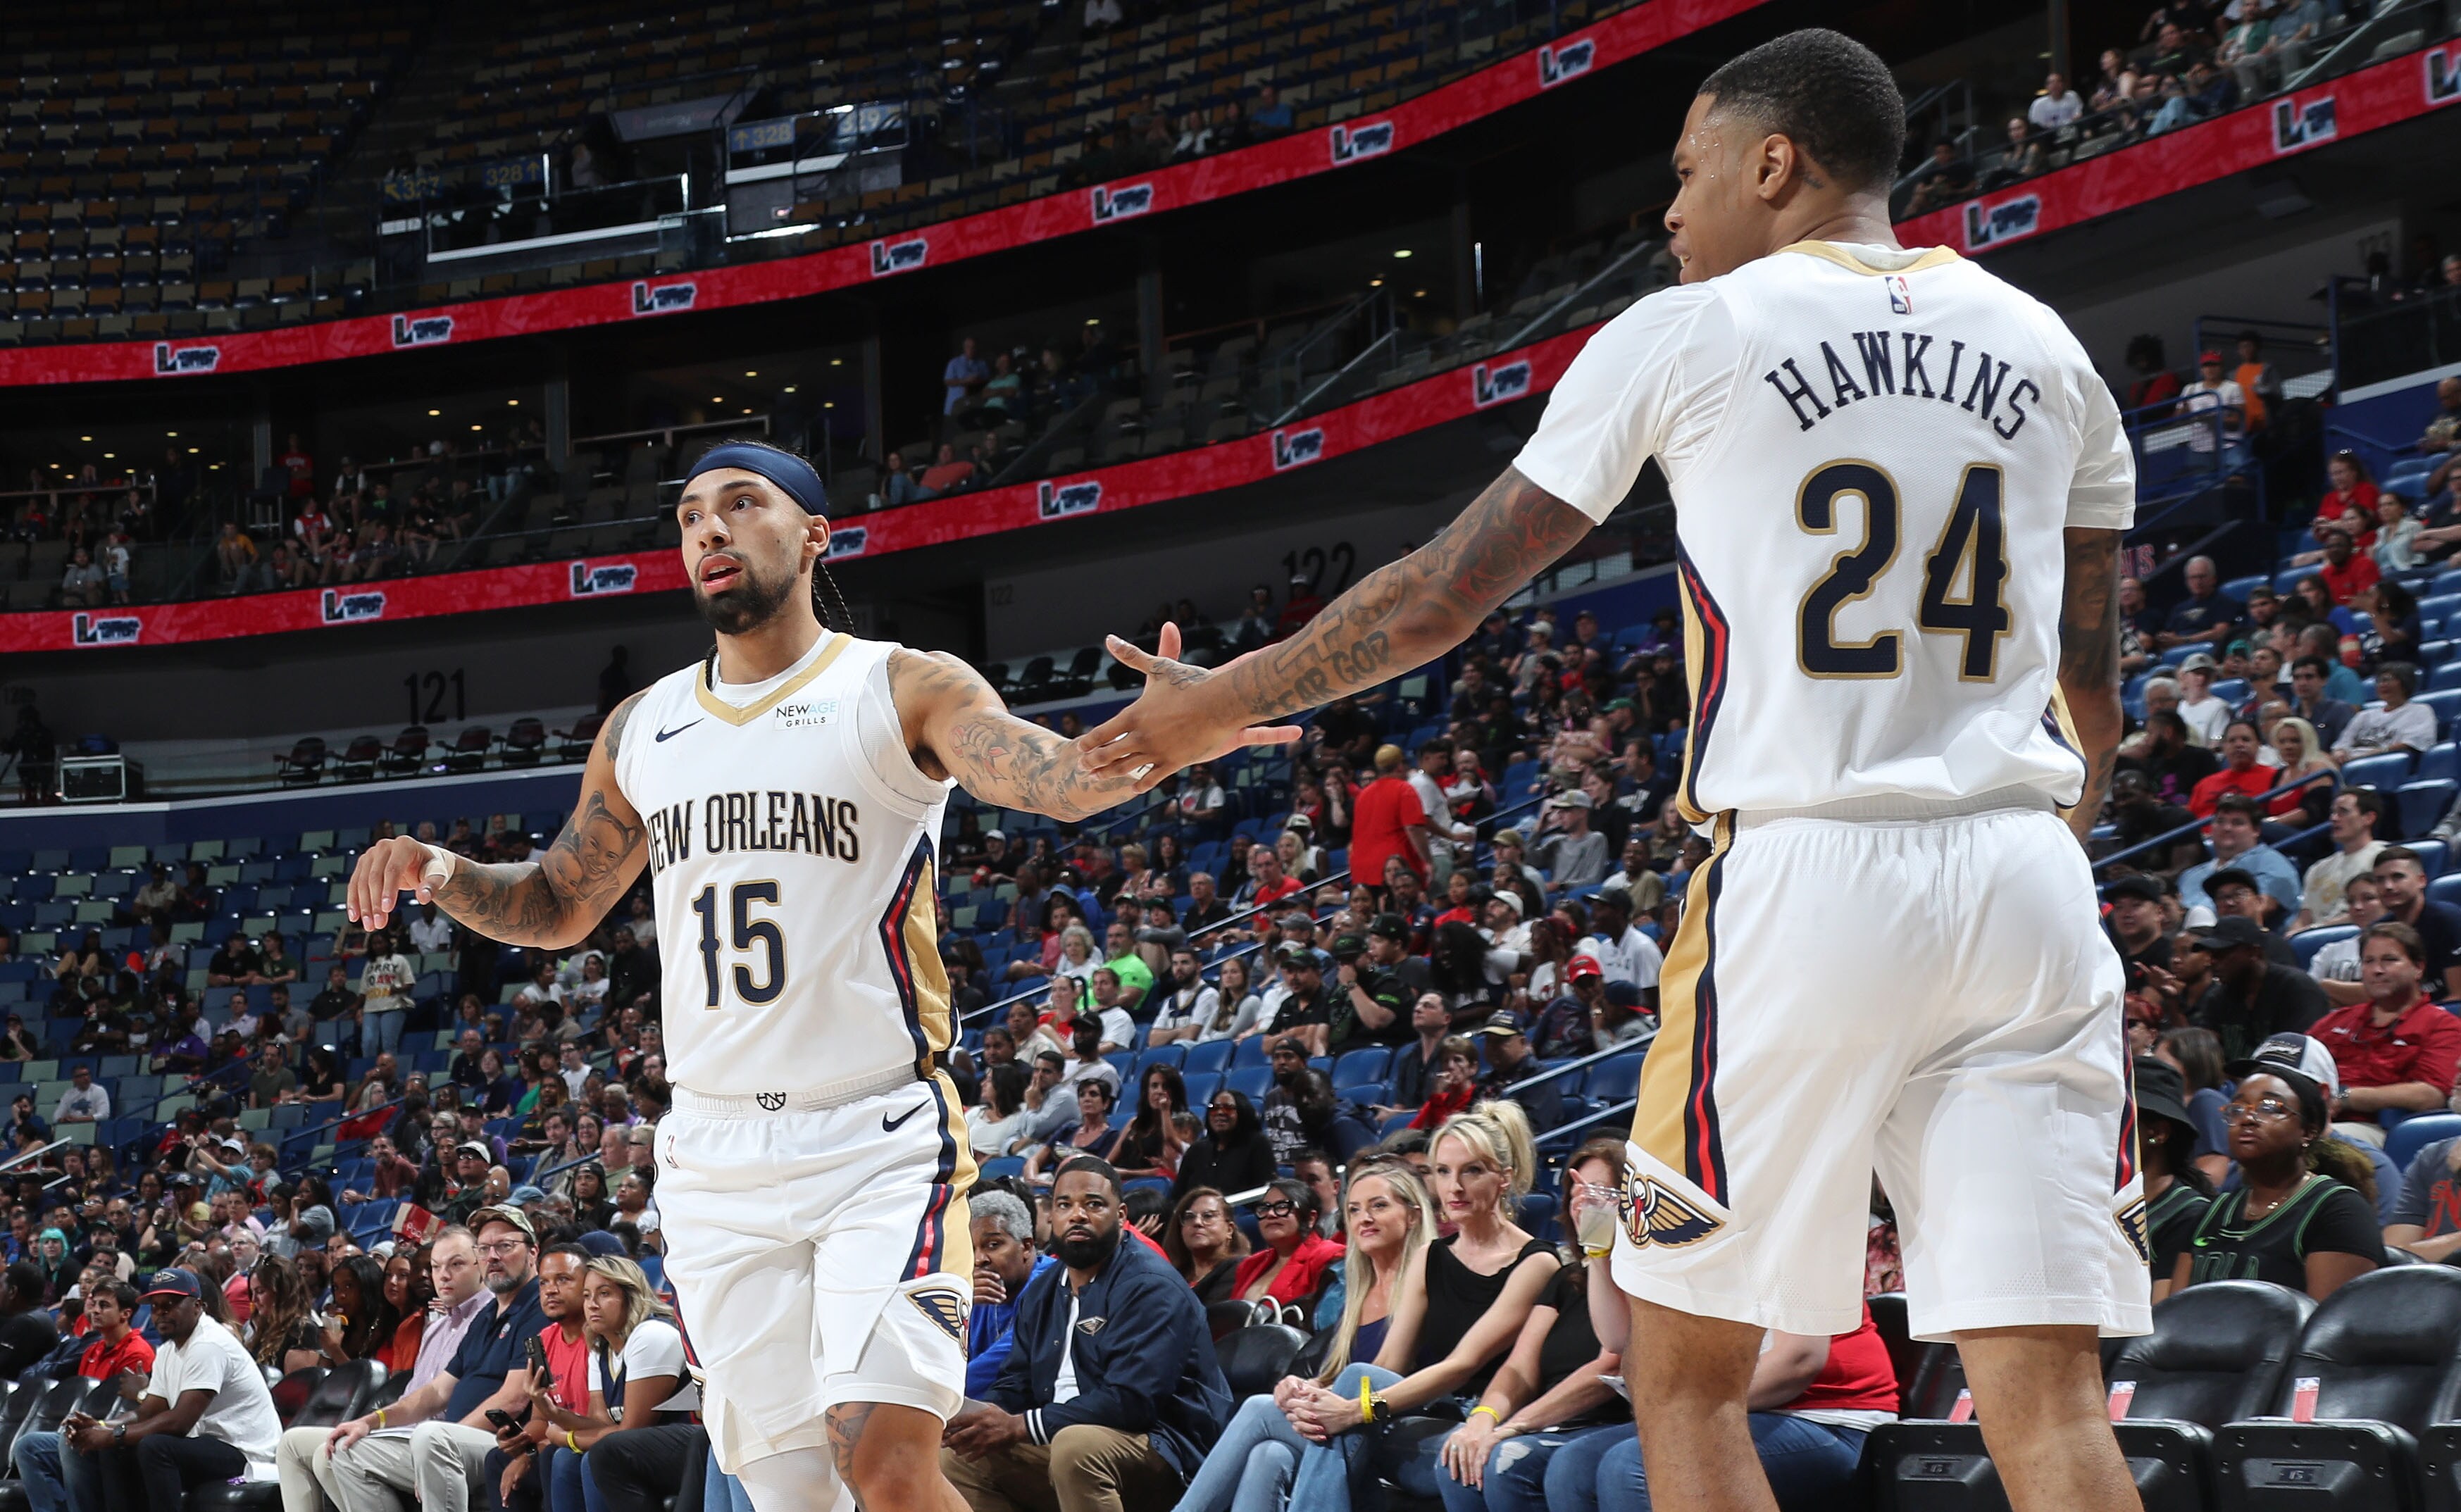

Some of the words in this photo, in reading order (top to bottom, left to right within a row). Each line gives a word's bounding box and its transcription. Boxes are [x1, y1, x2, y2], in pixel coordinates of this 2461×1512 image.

[1764, 331, 2040, 440] HAWKINS
[1281, 541, 1356, 604] 122
[1794, 458, 2014, 683] 24
[403, 666, 466, 726] 121
[785, 716, 827, 727] GRILLS
[705, 790, 861, 864] ORLEANS
[691, 878, 789, 1010] 15
[1550, 1167, 1563, 1187] 7
